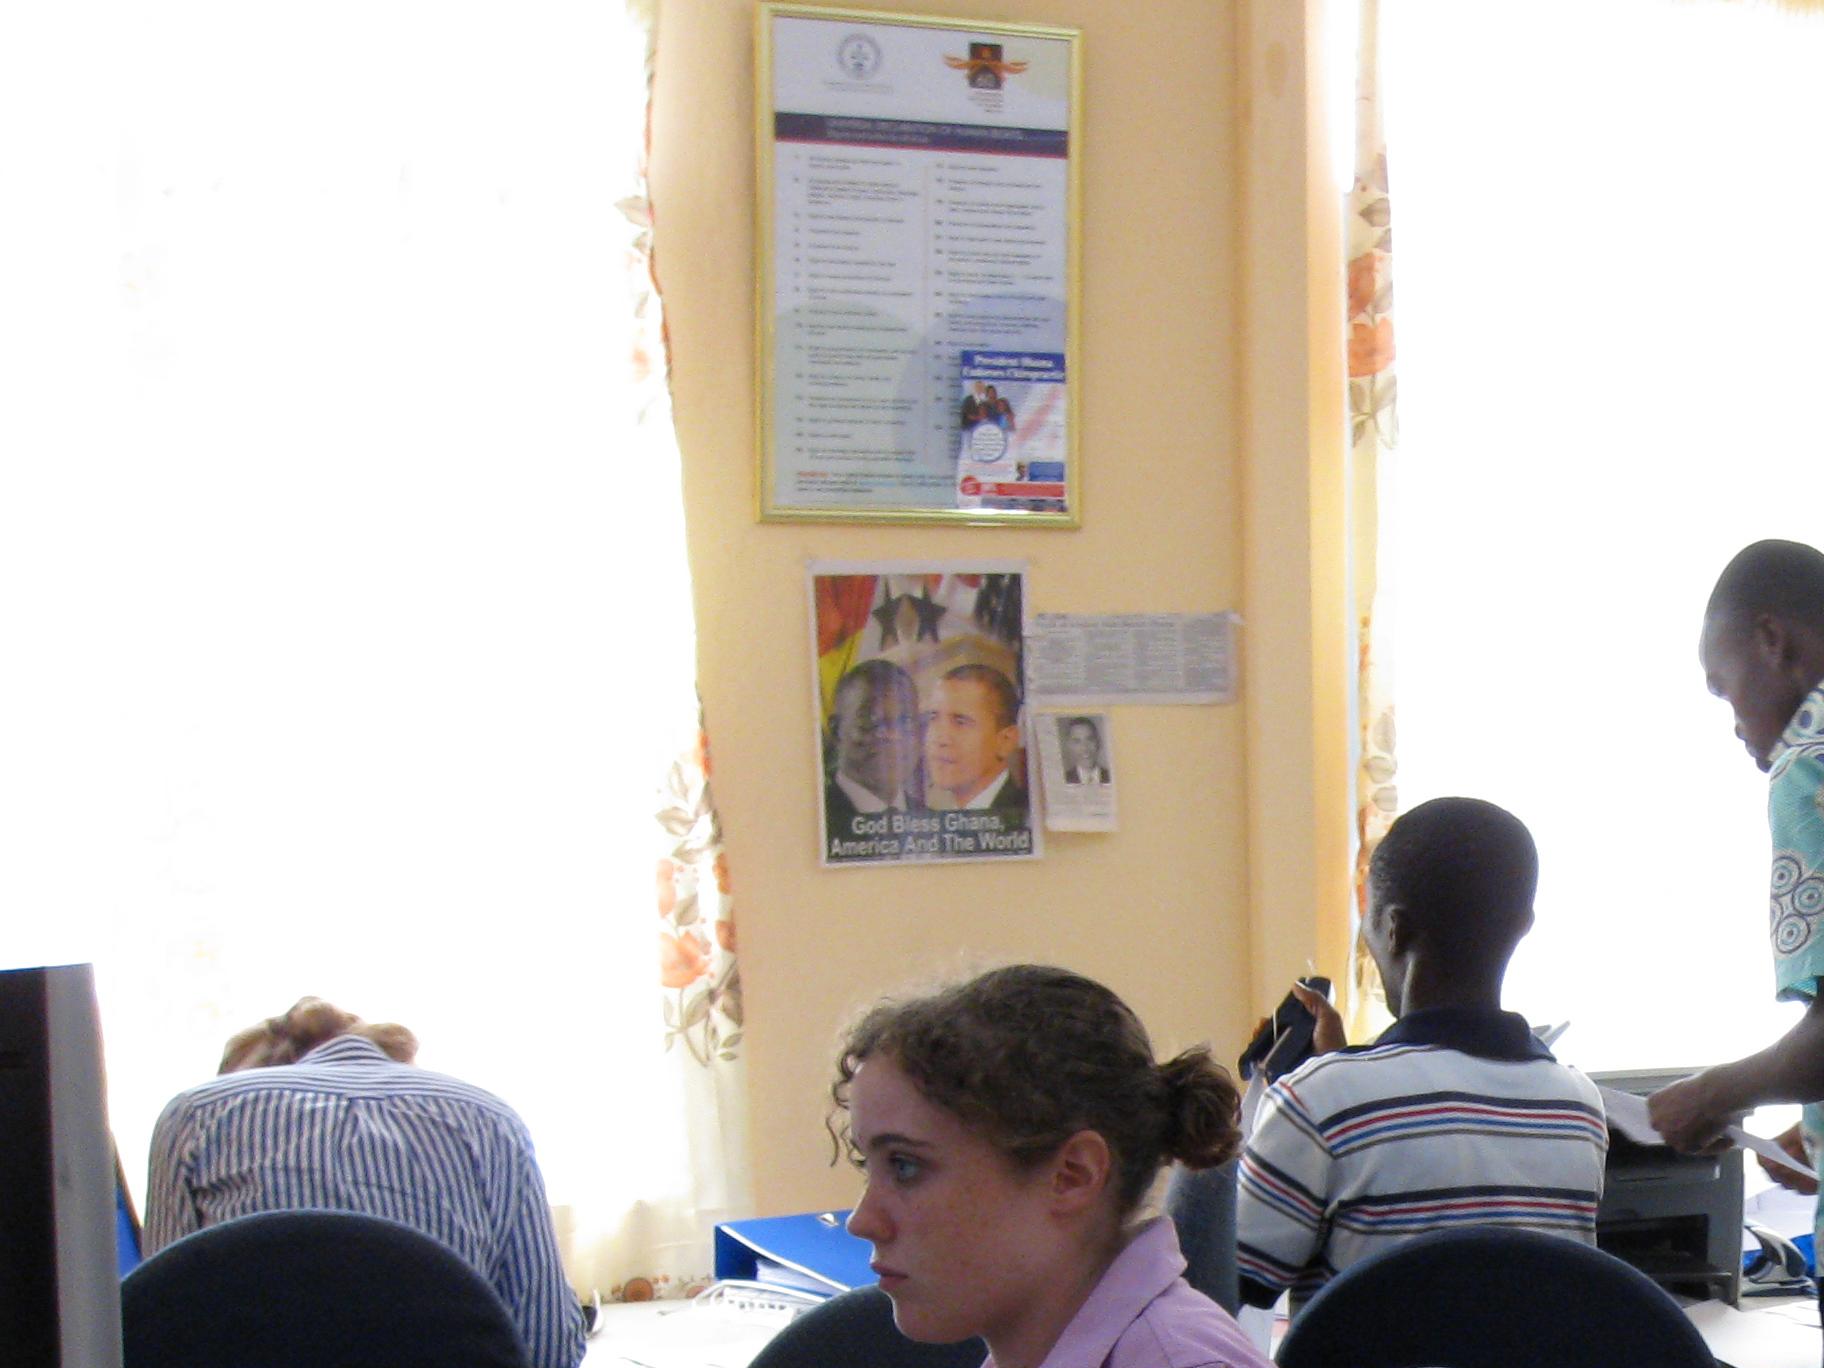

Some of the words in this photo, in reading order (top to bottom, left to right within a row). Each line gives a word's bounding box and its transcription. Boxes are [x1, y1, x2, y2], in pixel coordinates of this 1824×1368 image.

[852, 816, 889, 834] God
[893, 814, 940, 833] Bless
[944, 813, 1005, 833] Ghana,
[831, 838, 899, 856] America
[904, 834, 940, 853] And
[942, 832, 976, 852] The
[977, 830, 1032, 850] World
